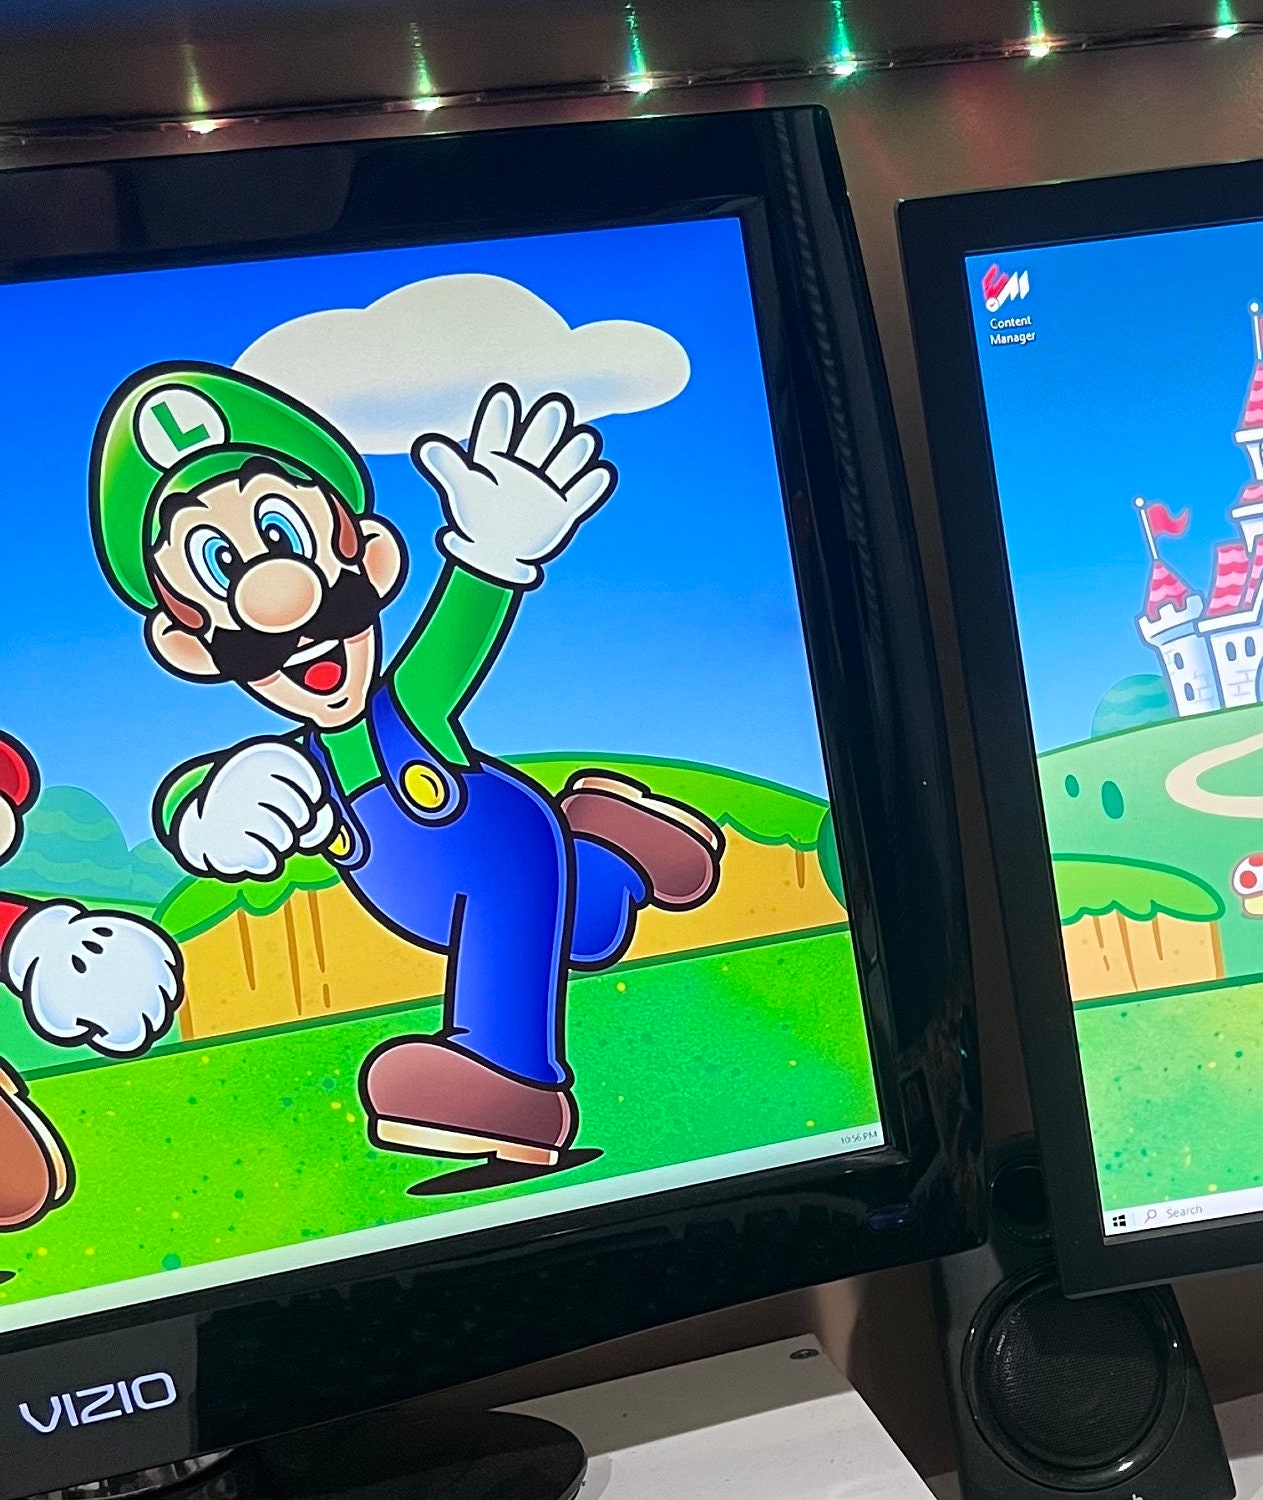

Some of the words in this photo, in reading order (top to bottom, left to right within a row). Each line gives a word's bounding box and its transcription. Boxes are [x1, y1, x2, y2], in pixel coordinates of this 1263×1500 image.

[989, 315, 1032, 330] Content
[989, 331, 1036, 346] Manager
[151, 401, 211, 452] L
[1166, 1205, 1203, 1219] Search
[18, 1372, 177, 1433] VIZIO
